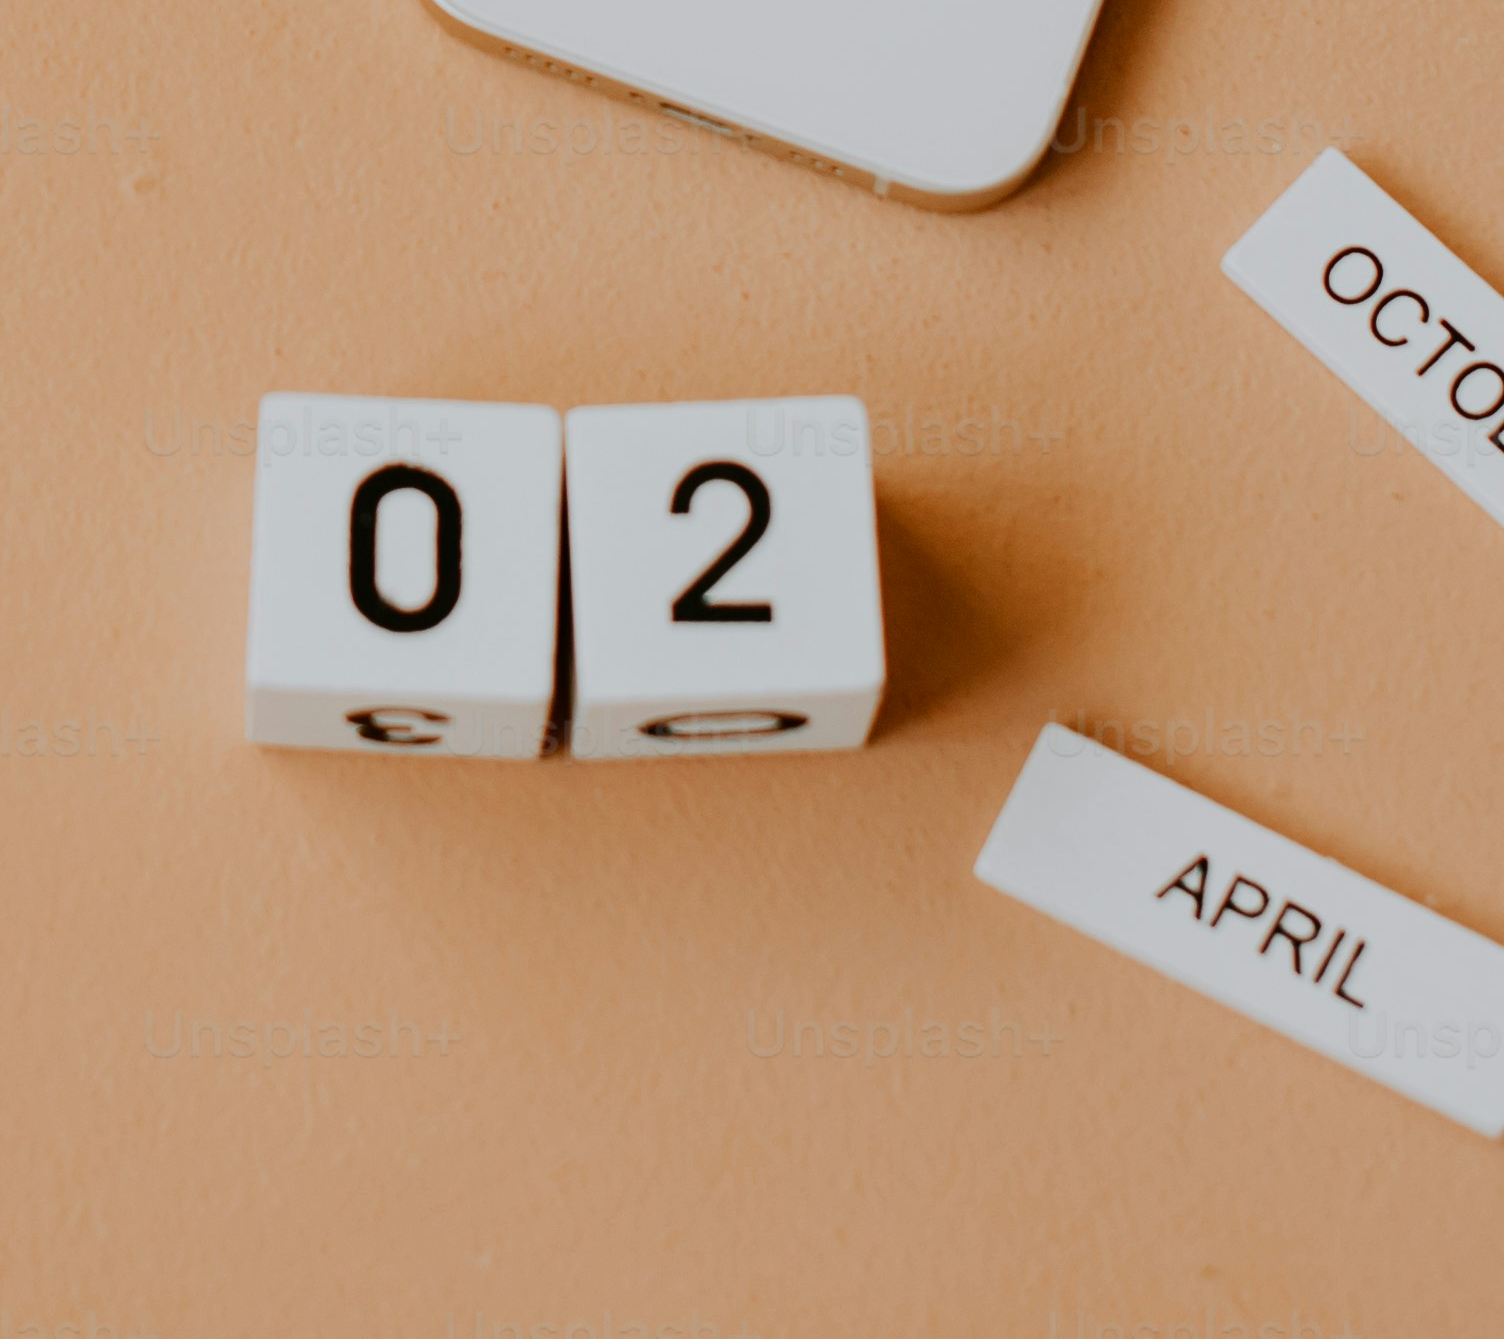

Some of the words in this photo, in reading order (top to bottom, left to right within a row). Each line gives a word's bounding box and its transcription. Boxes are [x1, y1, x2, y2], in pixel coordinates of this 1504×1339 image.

[347, 461, 464, 634] 0
[668, 459, 774, 625] 2
[1156, 855, 1367, 1010] APRIL
